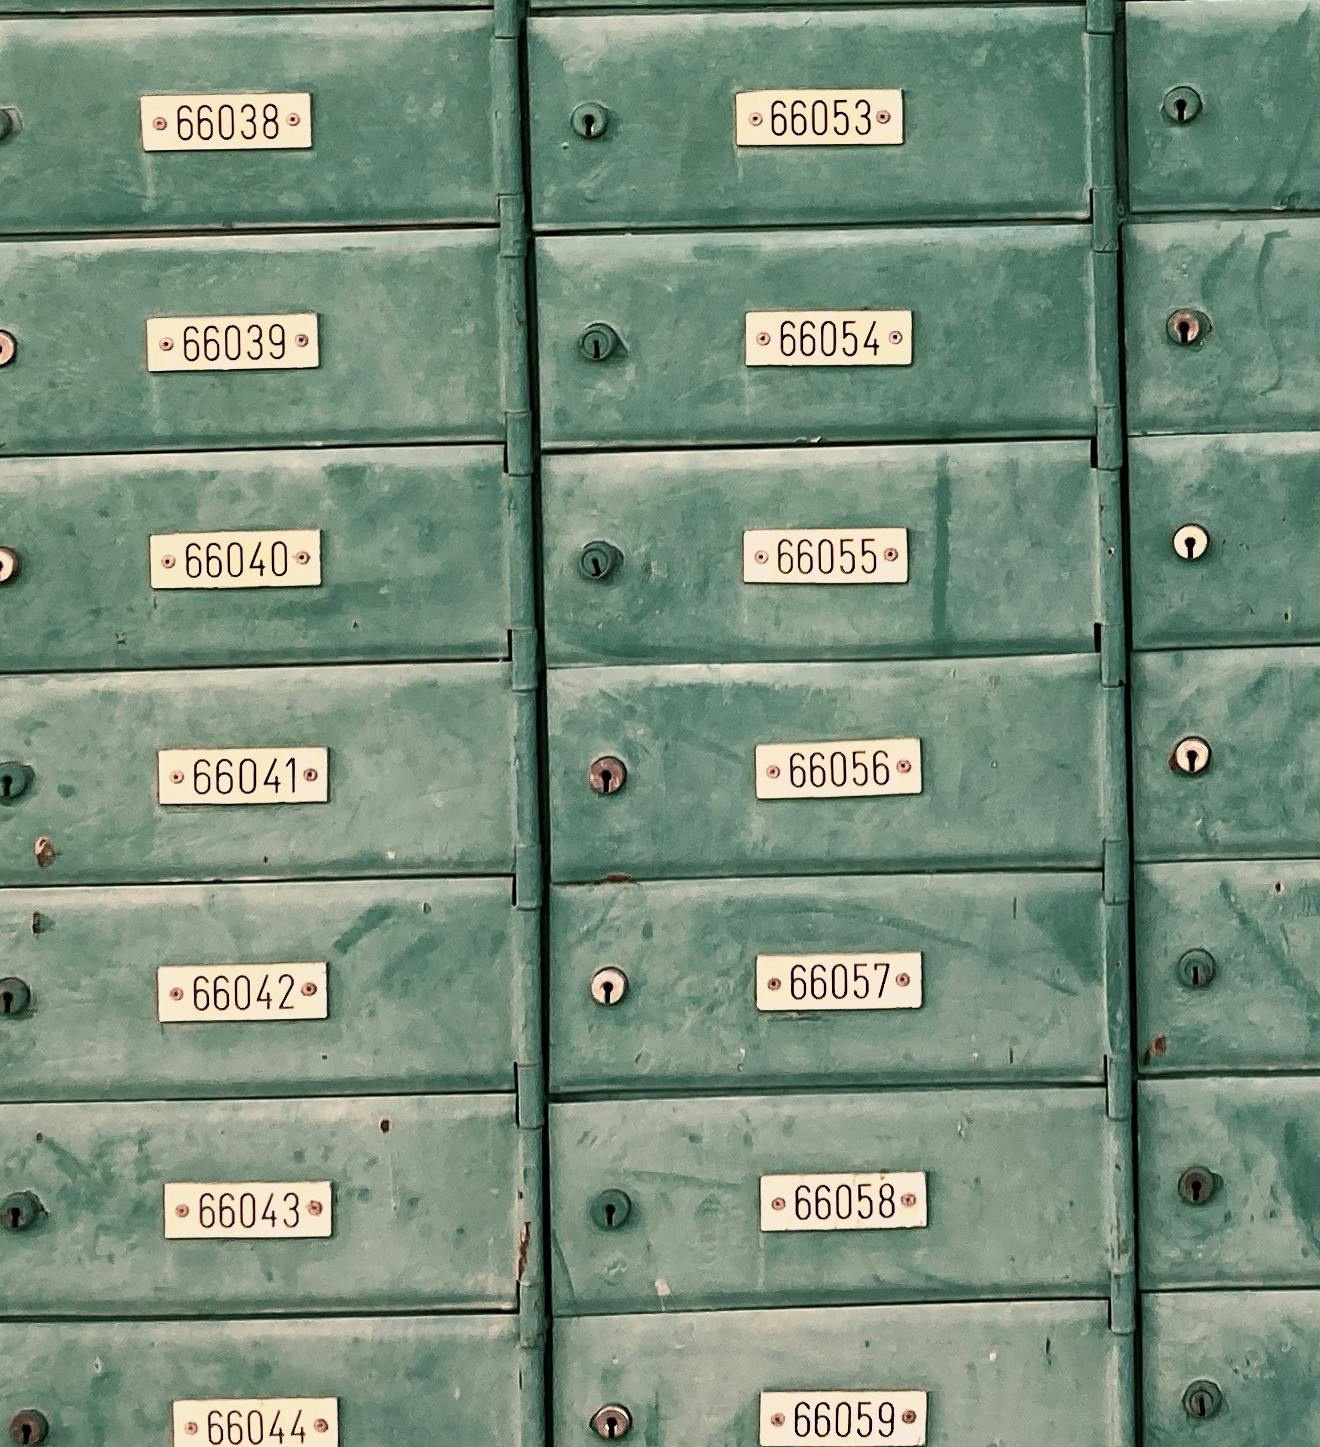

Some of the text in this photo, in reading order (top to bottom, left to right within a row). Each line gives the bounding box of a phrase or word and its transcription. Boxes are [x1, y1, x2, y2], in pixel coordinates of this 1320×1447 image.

[176, 103, 280, 142] 66038
[770, 98, 872, 137] 66053
[183, 323, 286, 362] 66039
[780, 320, 880, 358] 66054
[185, 540, 288, 579] 66040
[777, 538, 877, 575] 66055
[193, 757, 296, 795] 66041
[789, 749, 890, 789] 66056
[193, 973, 295, 1012] 66042
[790, 962, 890, 1001] 66057
[199, 1192, 300, 1229] 66043
[794, 1182, 896, 1221] 66058
[207, 1409, 306, 1446] 66044
[794, 1401, 895, 1438] 66059
